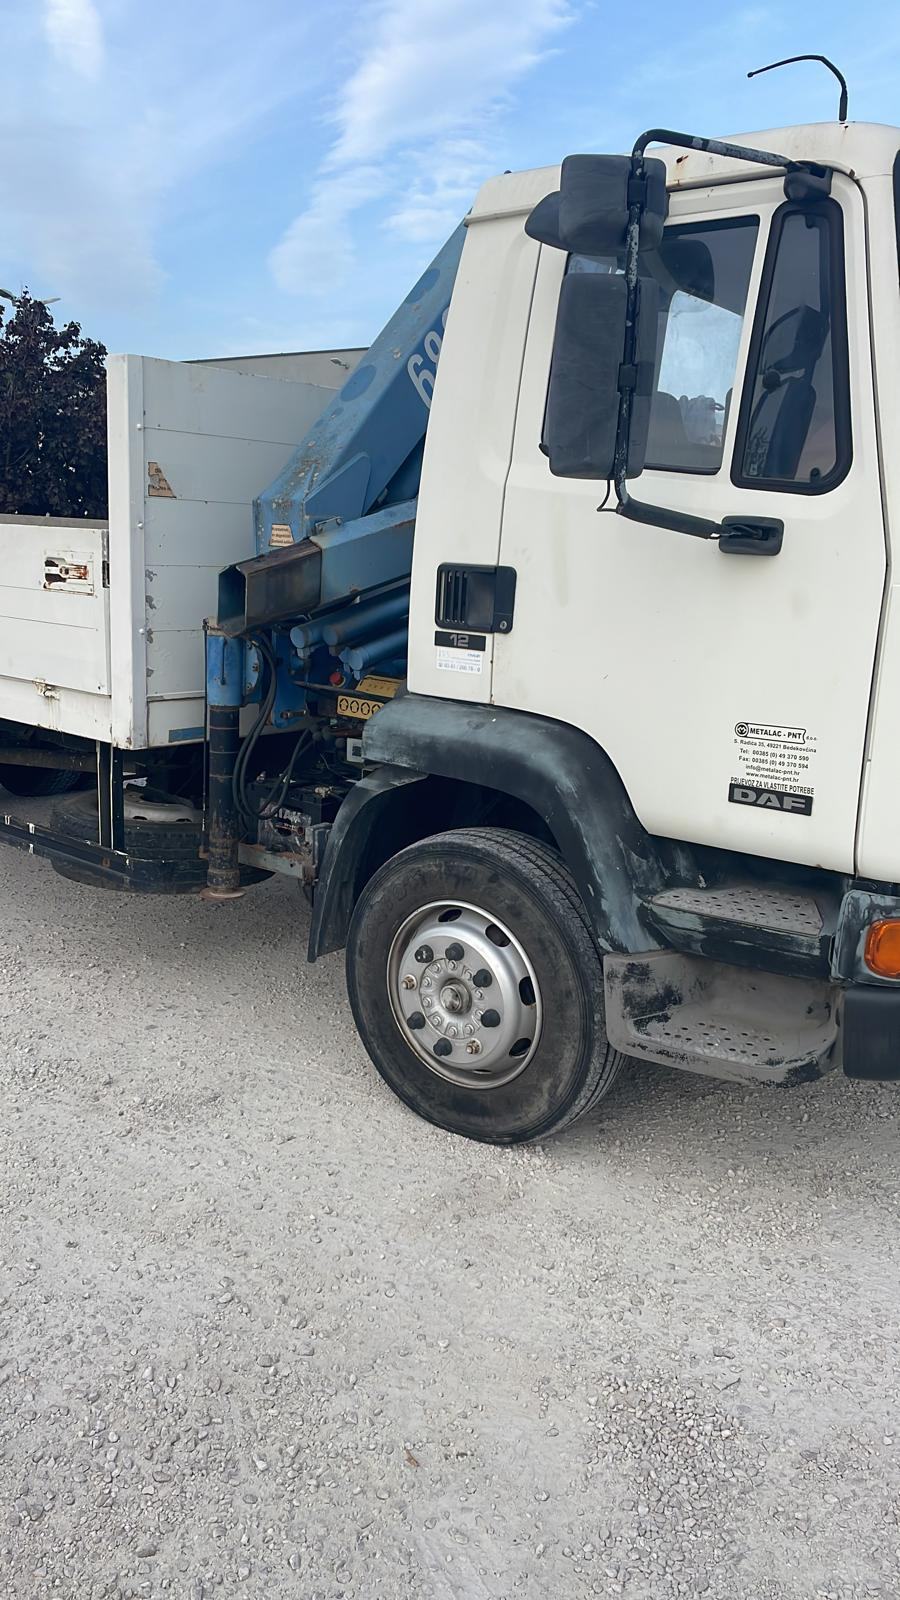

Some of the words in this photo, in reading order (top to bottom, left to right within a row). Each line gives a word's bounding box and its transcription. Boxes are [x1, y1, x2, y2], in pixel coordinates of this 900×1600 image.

[450, 634, 469, 647] 12
[750, 728, 782, 737] METALAC
[746, 764, 800, 776] info@metalac-pnt.hr
[746, 772, 799, 783] www.metalac-pnt.hr
[730, 776, 755, 788] PRIJEVOZ
[756, 780, 762, 788] ZA
[763, 781, 788, 792] VLASTITE
[789, 784, 815, 795] POTREBE
[733, 787, 806, 810] DAF
